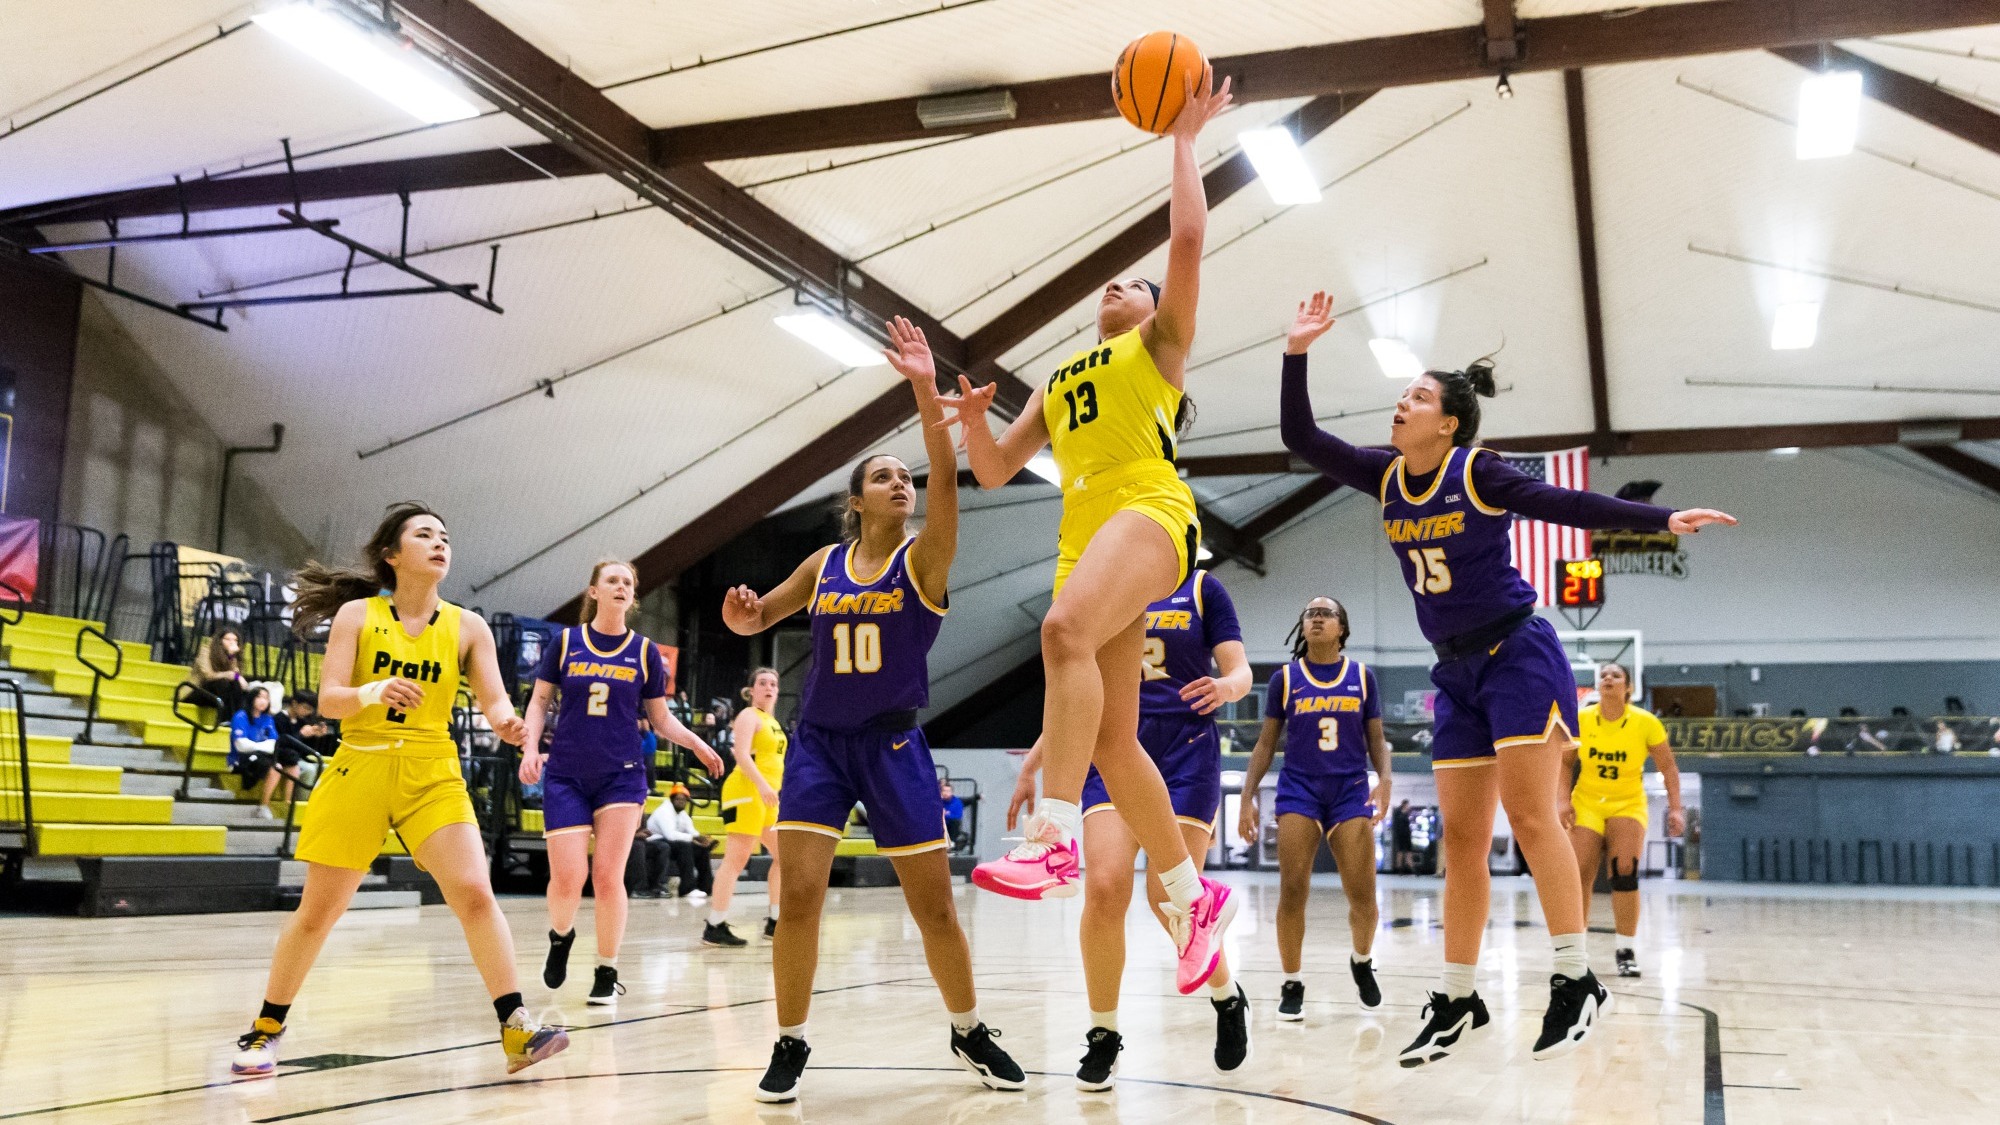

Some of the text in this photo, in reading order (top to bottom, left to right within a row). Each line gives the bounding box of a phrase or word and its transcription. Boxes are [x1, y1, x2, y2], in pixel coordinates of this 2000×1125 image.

[1048, 347, 1112, 395] Pratt
[1064, 381, 1098, 432] 13
[1384, 511, 1466, 543] HUNTER
[1408, 547, 1452, 596] 15
[815, 588, 905, 616] HUNTER
[1563, 576, 1597, 605] 21
[1146, 610, 1192, 630] TER
[833, 623, 882, 673] 10
[373, 651, 442, 683] Pratt
[567, 661, 638, 683] HUNTER
[587, 682, 610, 716] 2
[1294, 696, 1361, 715] HUNTER
[1318, 717, 1338, 751] 3
[1668, 722, 1796, 749] LETICS
[1589, 747, 1627, 762] Pratt
[1597, 764, 1619, 780] 23
